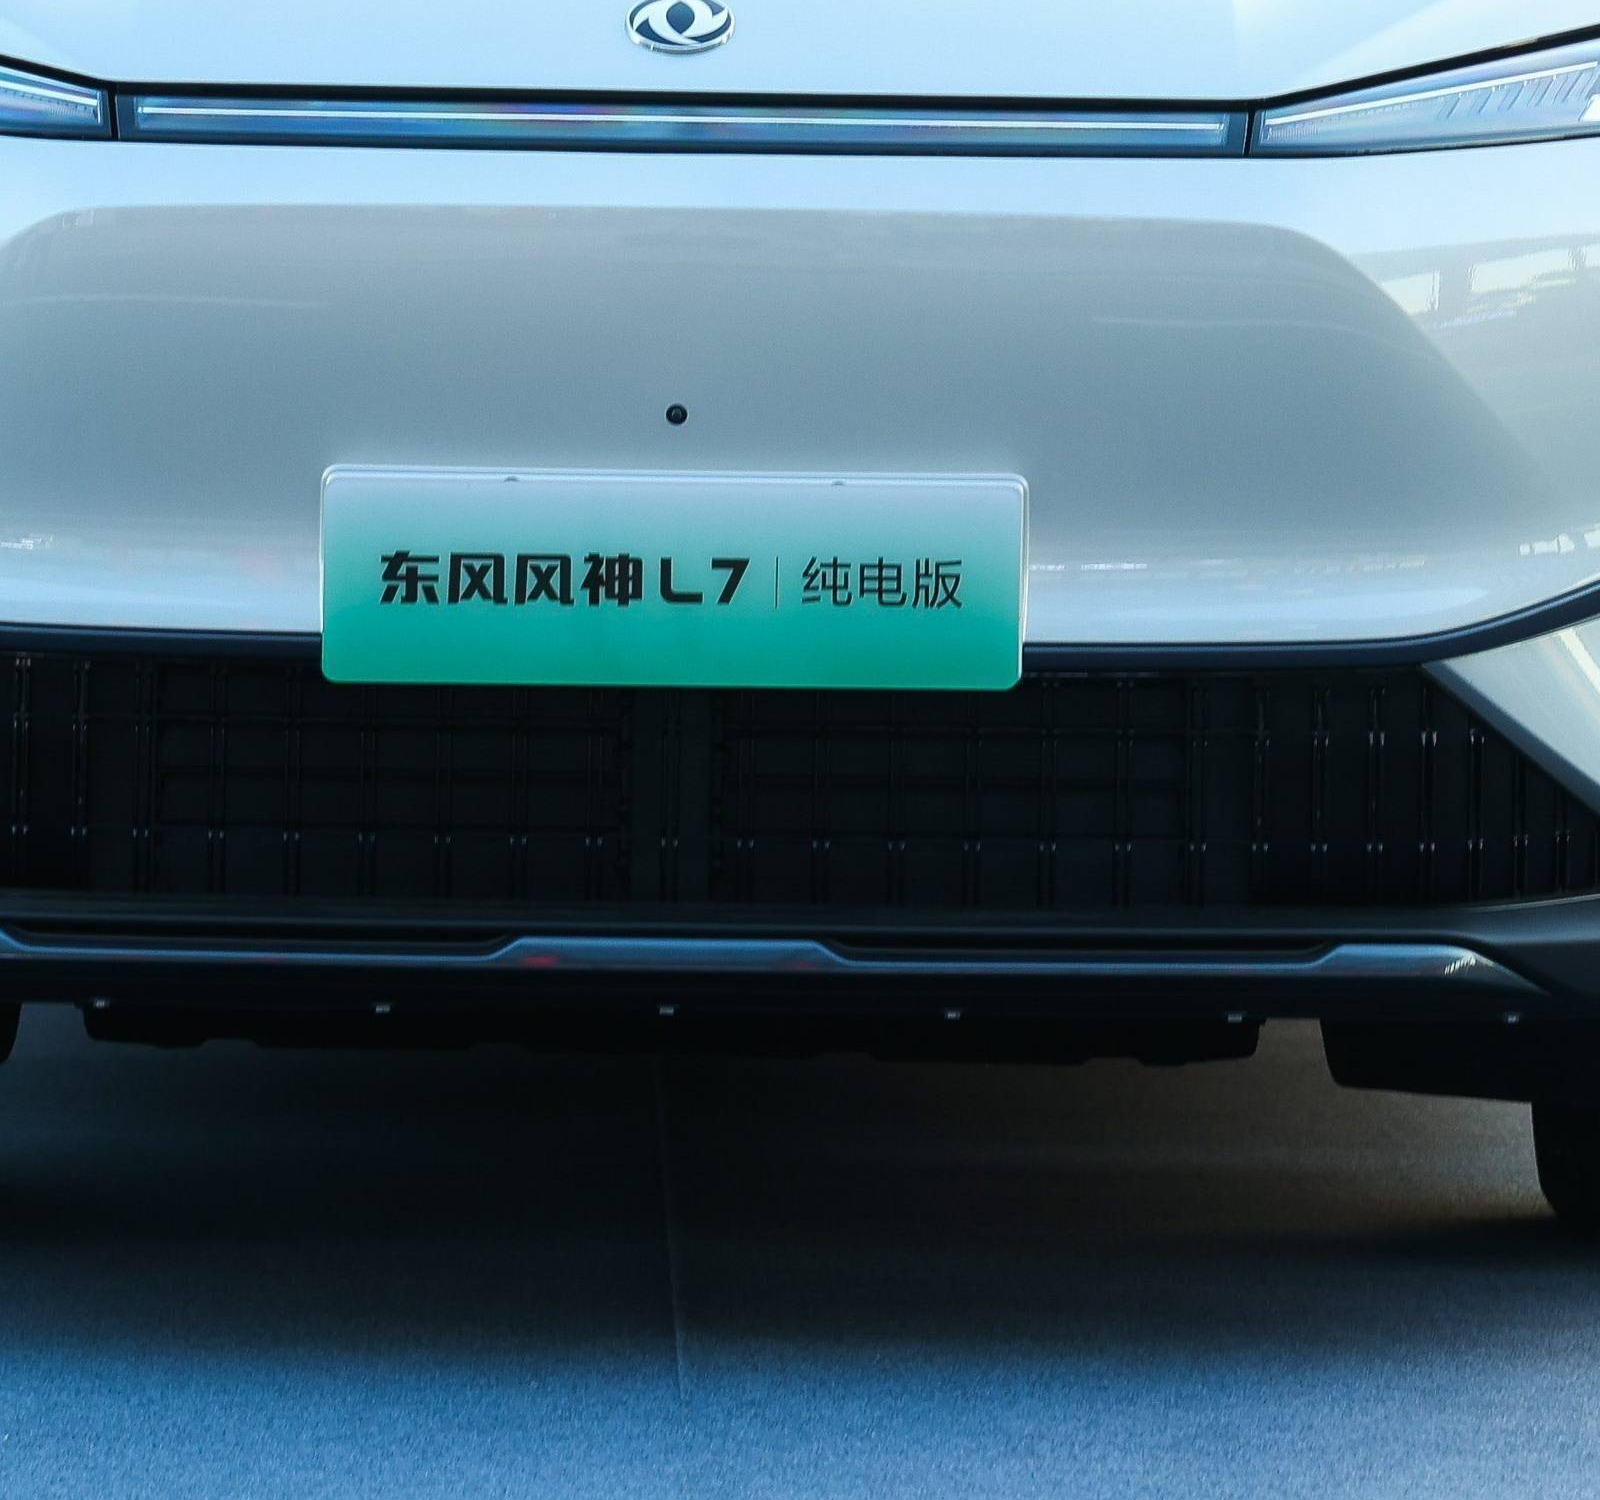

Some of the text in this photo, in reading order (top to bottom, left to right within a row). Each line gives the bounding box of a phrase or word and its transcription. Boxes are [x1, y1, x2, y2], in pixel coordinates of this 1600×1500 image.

[380, 551, 963, 610] 东风风神L7 纯电版
